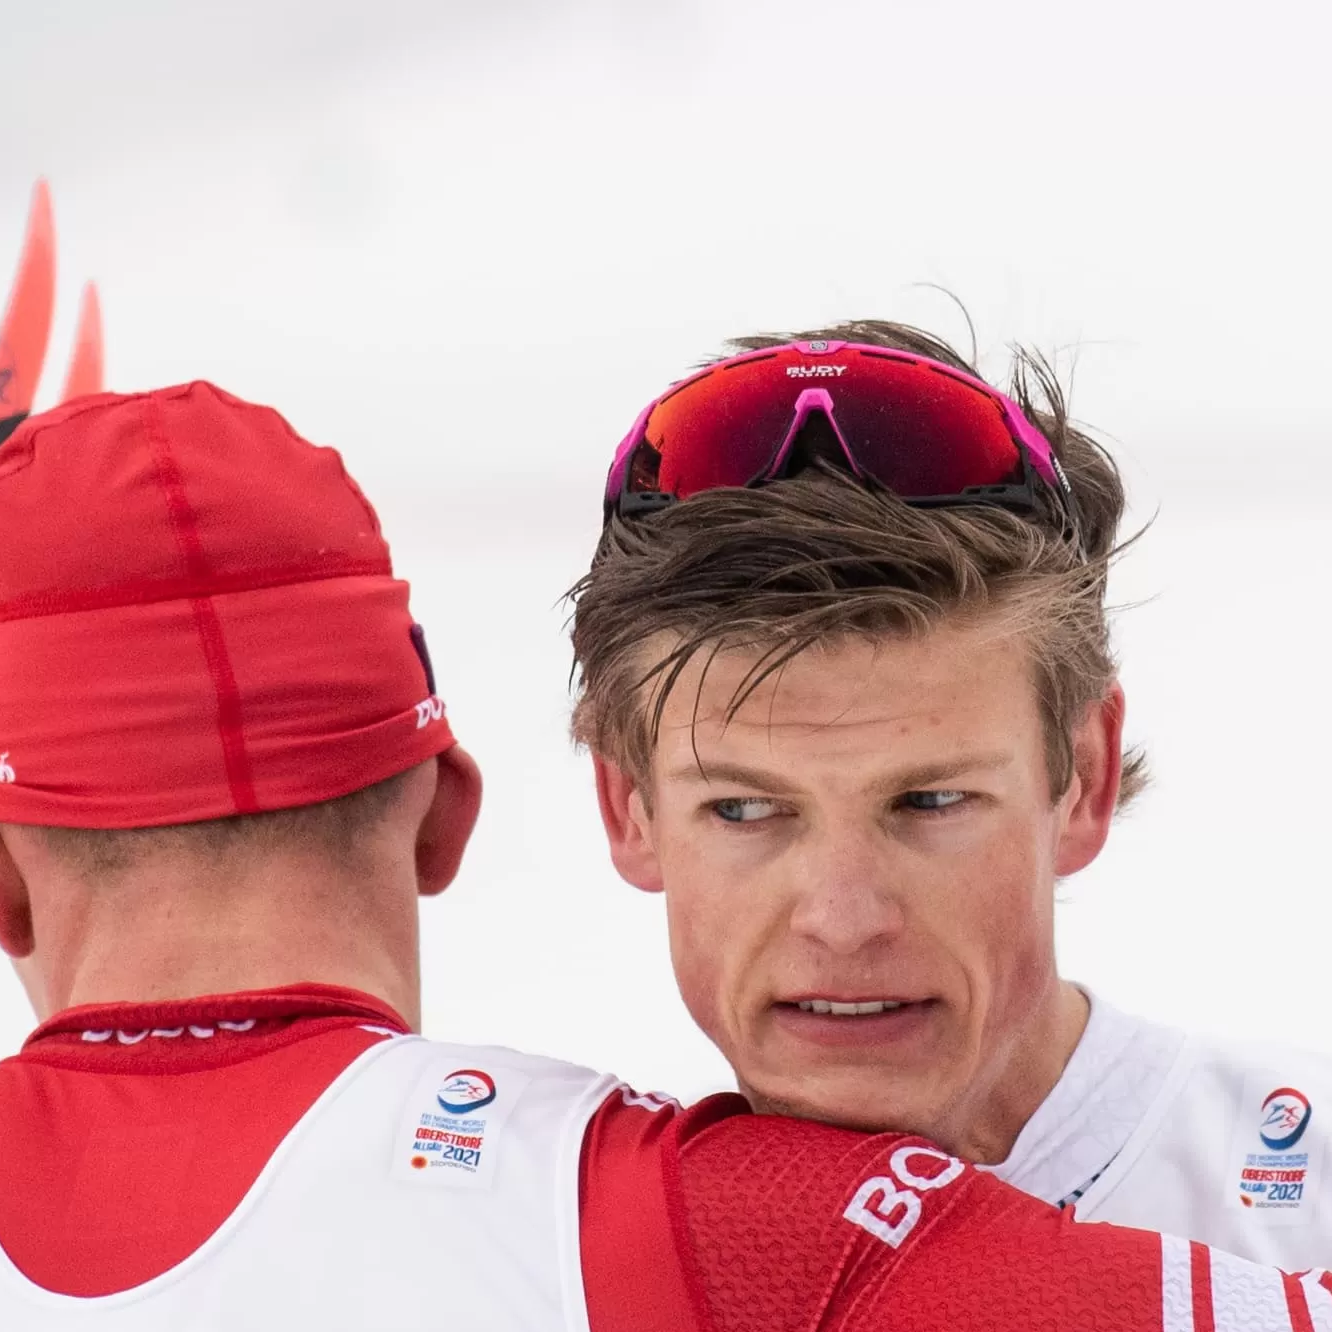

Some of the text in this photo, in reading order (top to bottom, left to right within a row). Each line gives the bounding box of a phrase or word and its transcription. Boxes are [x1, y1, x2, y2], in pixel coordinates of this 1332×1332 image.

[786, 365, 847, 376] RUDY
[415, 1127, 484, 1150] OBERSTDORF
[442, 1144, 481, 1167] 2021
[1267, 1183, 1304, 1201] 2021
